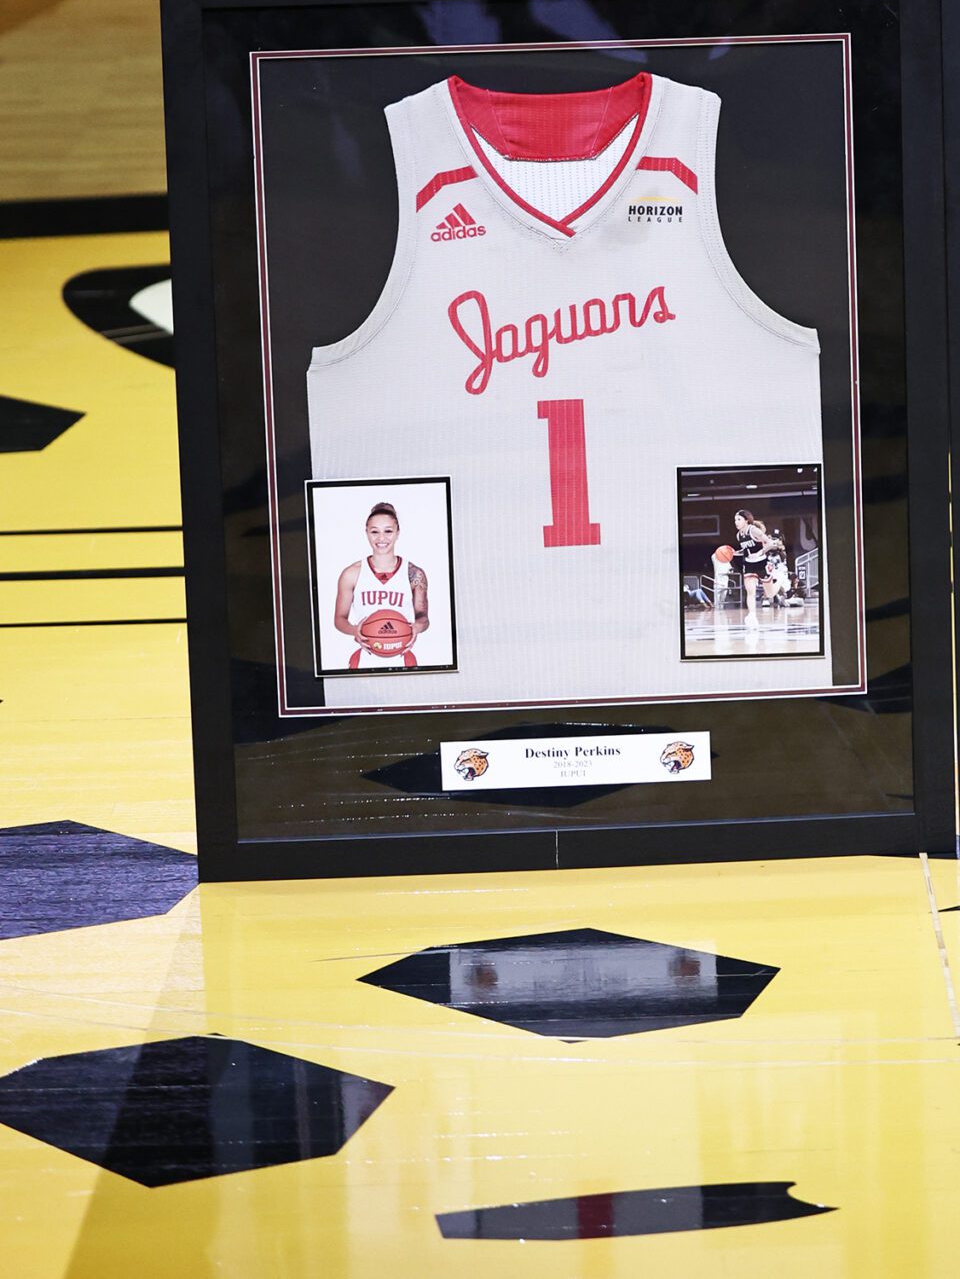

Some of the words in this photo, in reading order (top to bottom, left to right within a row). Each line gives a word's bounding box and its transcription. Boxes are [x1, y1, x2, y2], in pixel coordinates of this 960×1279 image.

[628, 205, 683, 216] HORIZON
[431, 224, 486, 242] adidas
[447, 286, 676, 395] Jaguars
[537, 399, 602, 548] 1
[361, 591, 404, 607] IUPUI
[525, 747, 569, 760] Destiny
[575, 746, 621, 757] Perkins
[560, 769, 587, 777] IUPUI
